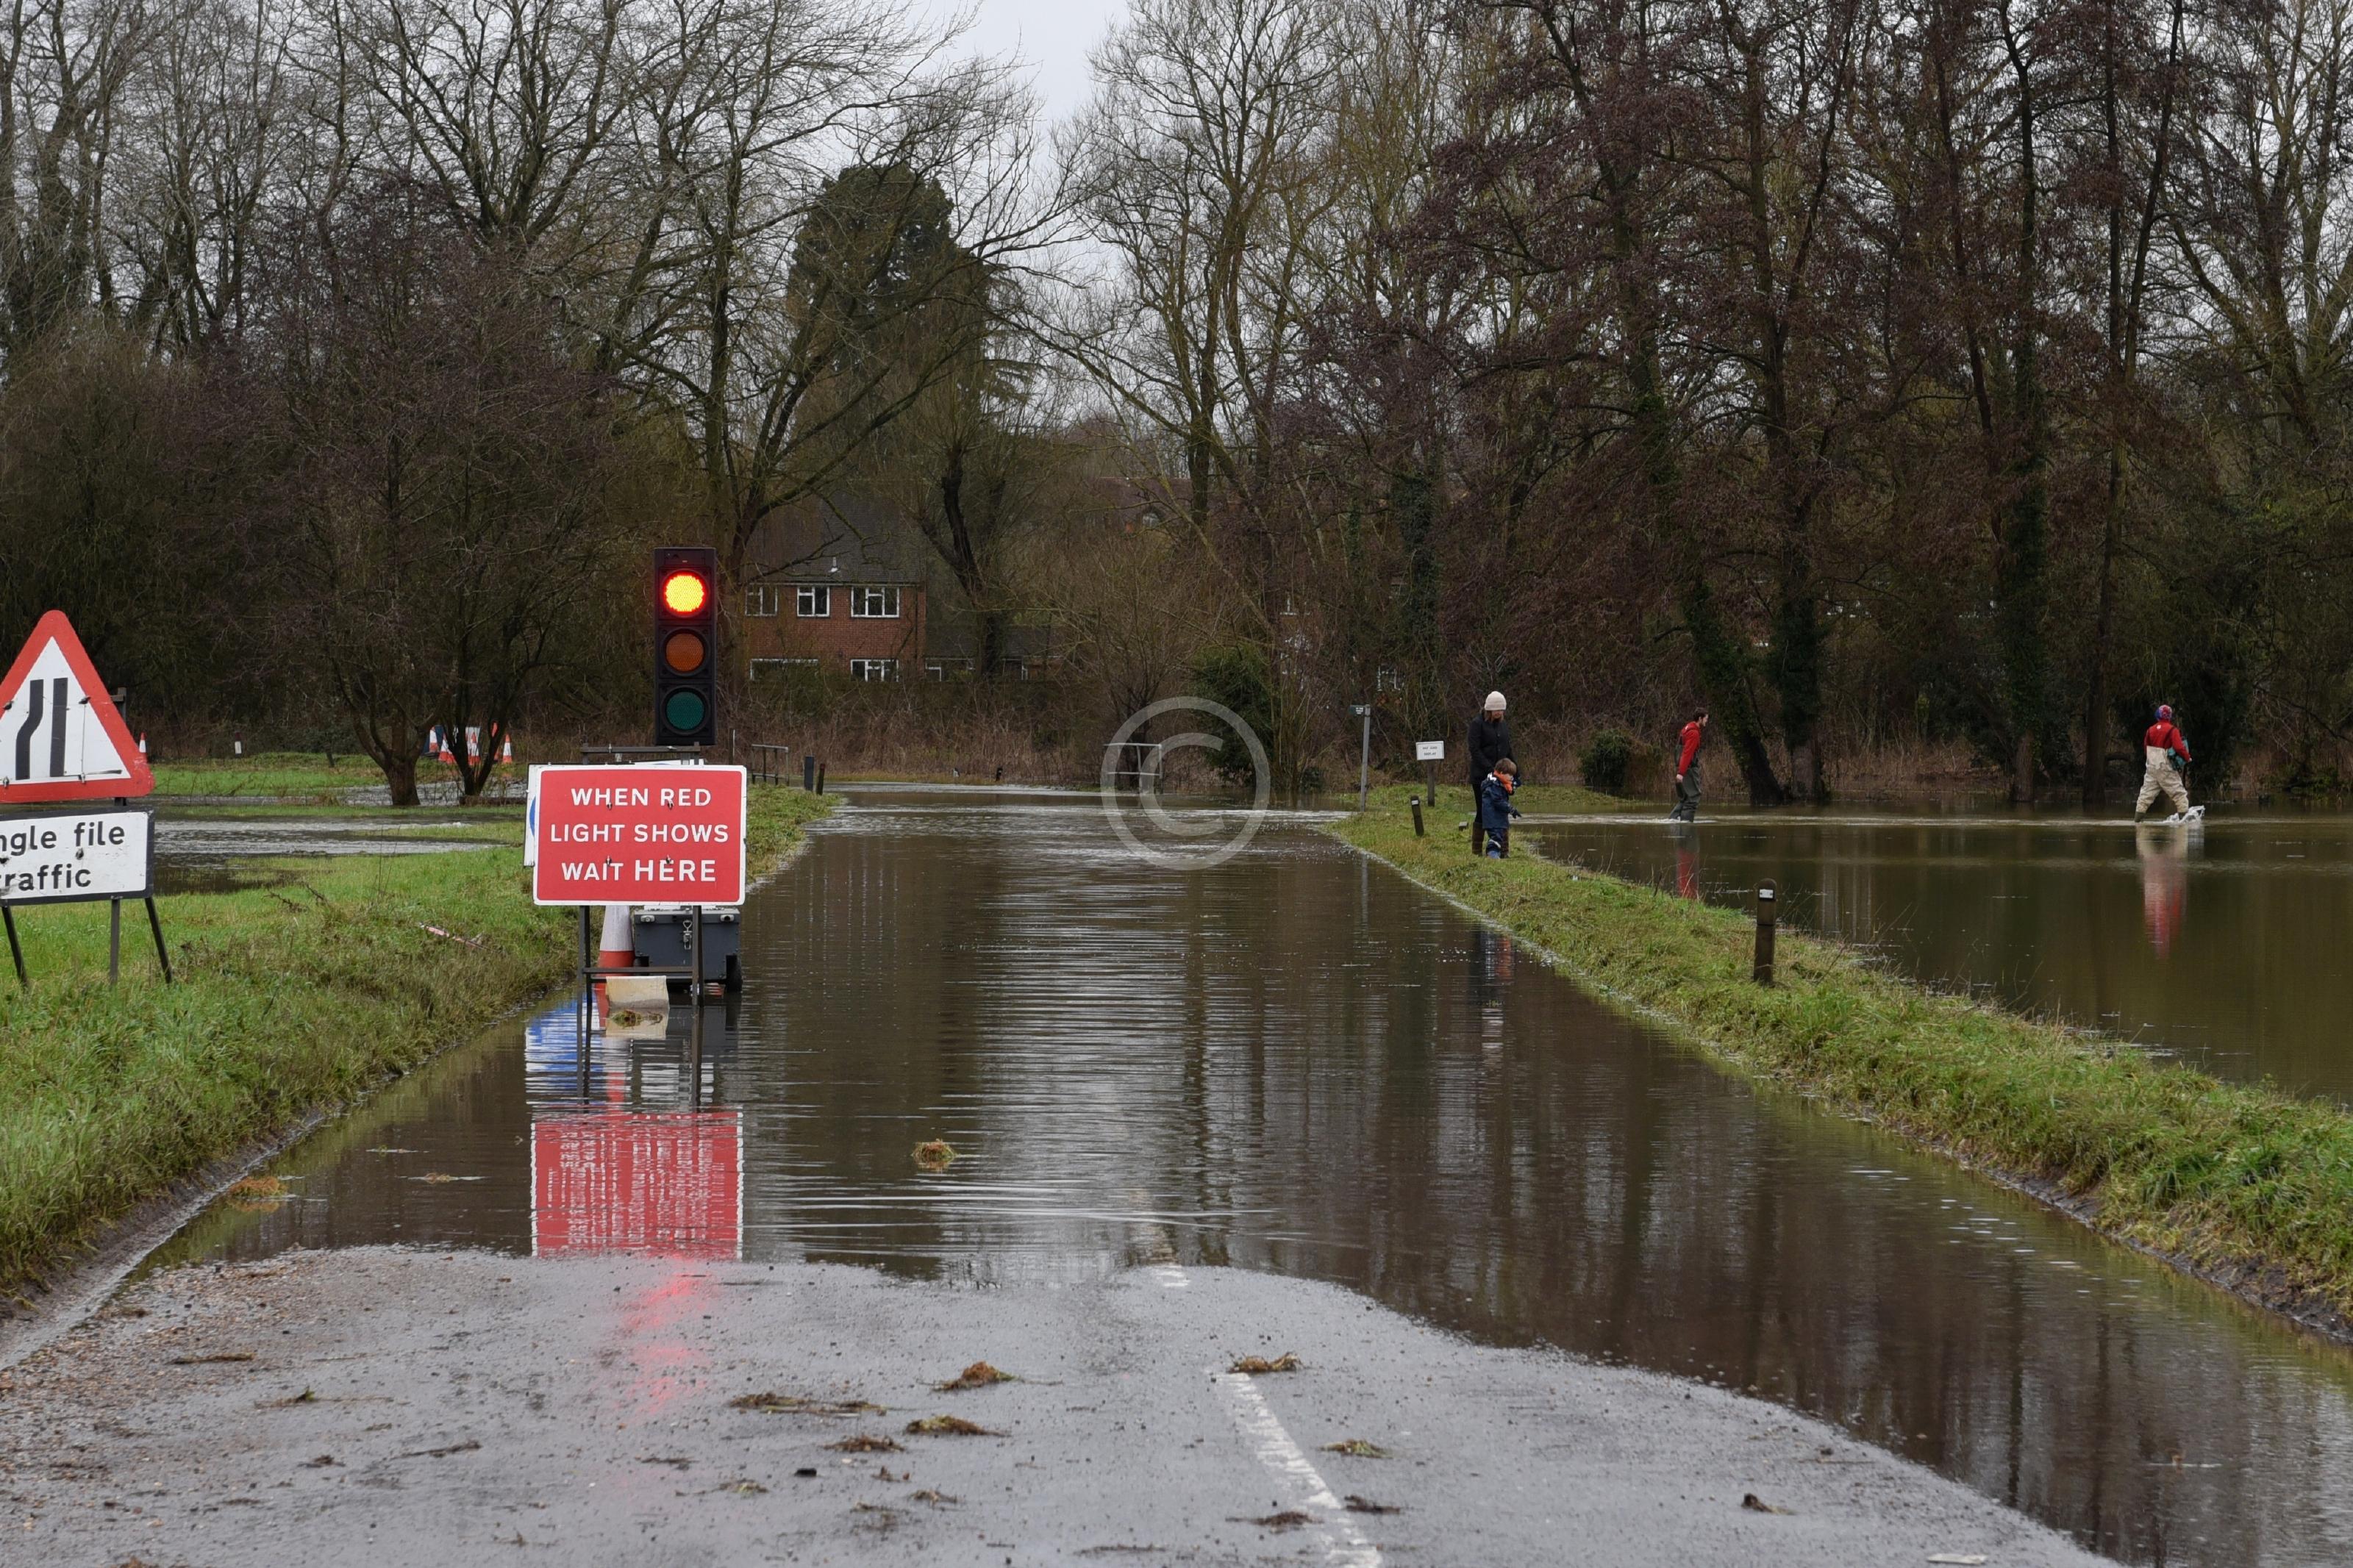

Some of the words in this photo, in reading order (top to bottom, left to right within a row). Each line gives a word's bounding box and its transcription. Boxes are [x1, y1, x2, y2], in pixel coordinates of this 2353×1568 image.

[571, 788, 649, 806] WHEN
[660, 788, 711, 806] RED
[74, 821, 125, 846] file
[551, 823, 625, 842] LIGHT
[634, 824, 729, 842] SHOWS
[0, 864, 91, 891] raffic
[561, 862, 624, 881] WAIT
[635, 859, 715, 881] HERE
